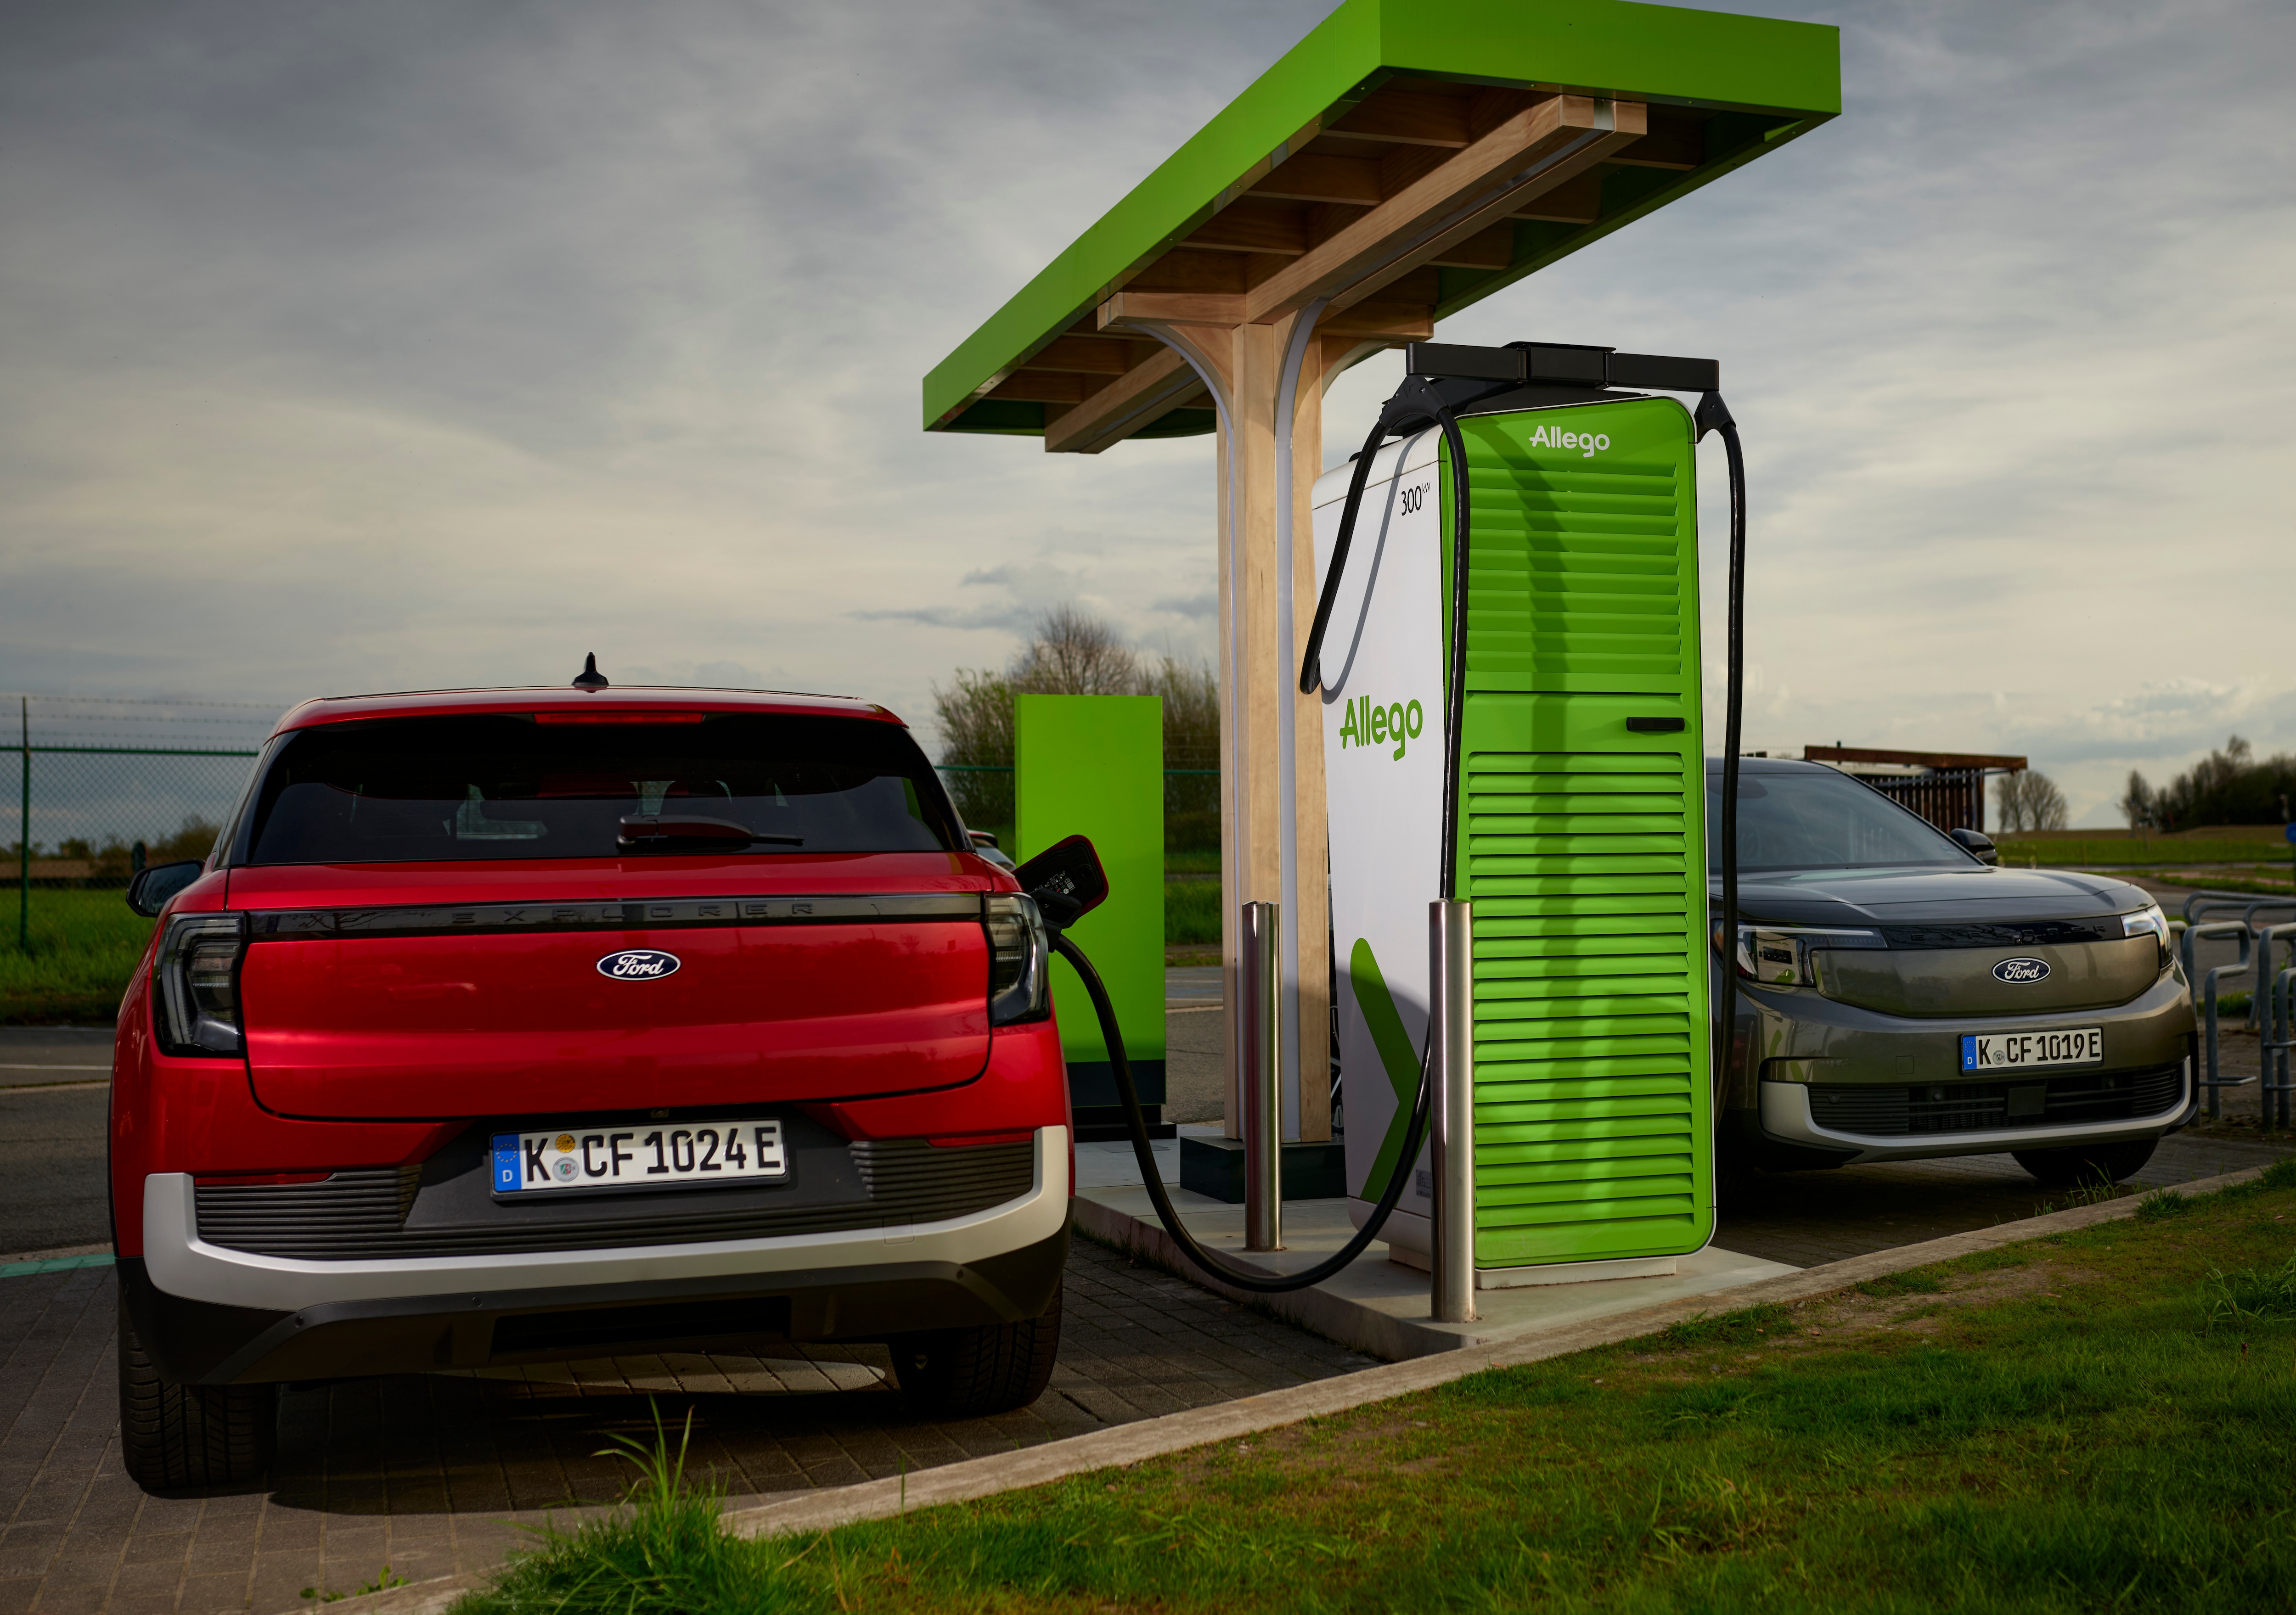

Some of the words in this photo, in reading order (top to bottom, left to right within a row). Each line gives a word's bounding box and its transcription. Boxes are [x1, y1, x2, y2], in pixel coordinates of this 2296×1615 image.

[1529, 425, 1610, 458] Allego
[1339, 695, 1423, 762] Allego
[452, 903, 814, 924] EXPLORER
[613, 954, 666, 976] Ford
[2004, 961, 2040, 980] Ford
[1967, 1056, 1973, 1065] D
[1978, 1039, 1991, 1065] K
[524, 1138, 551, 1182] K
[502, 1169, 513, 1183] D
